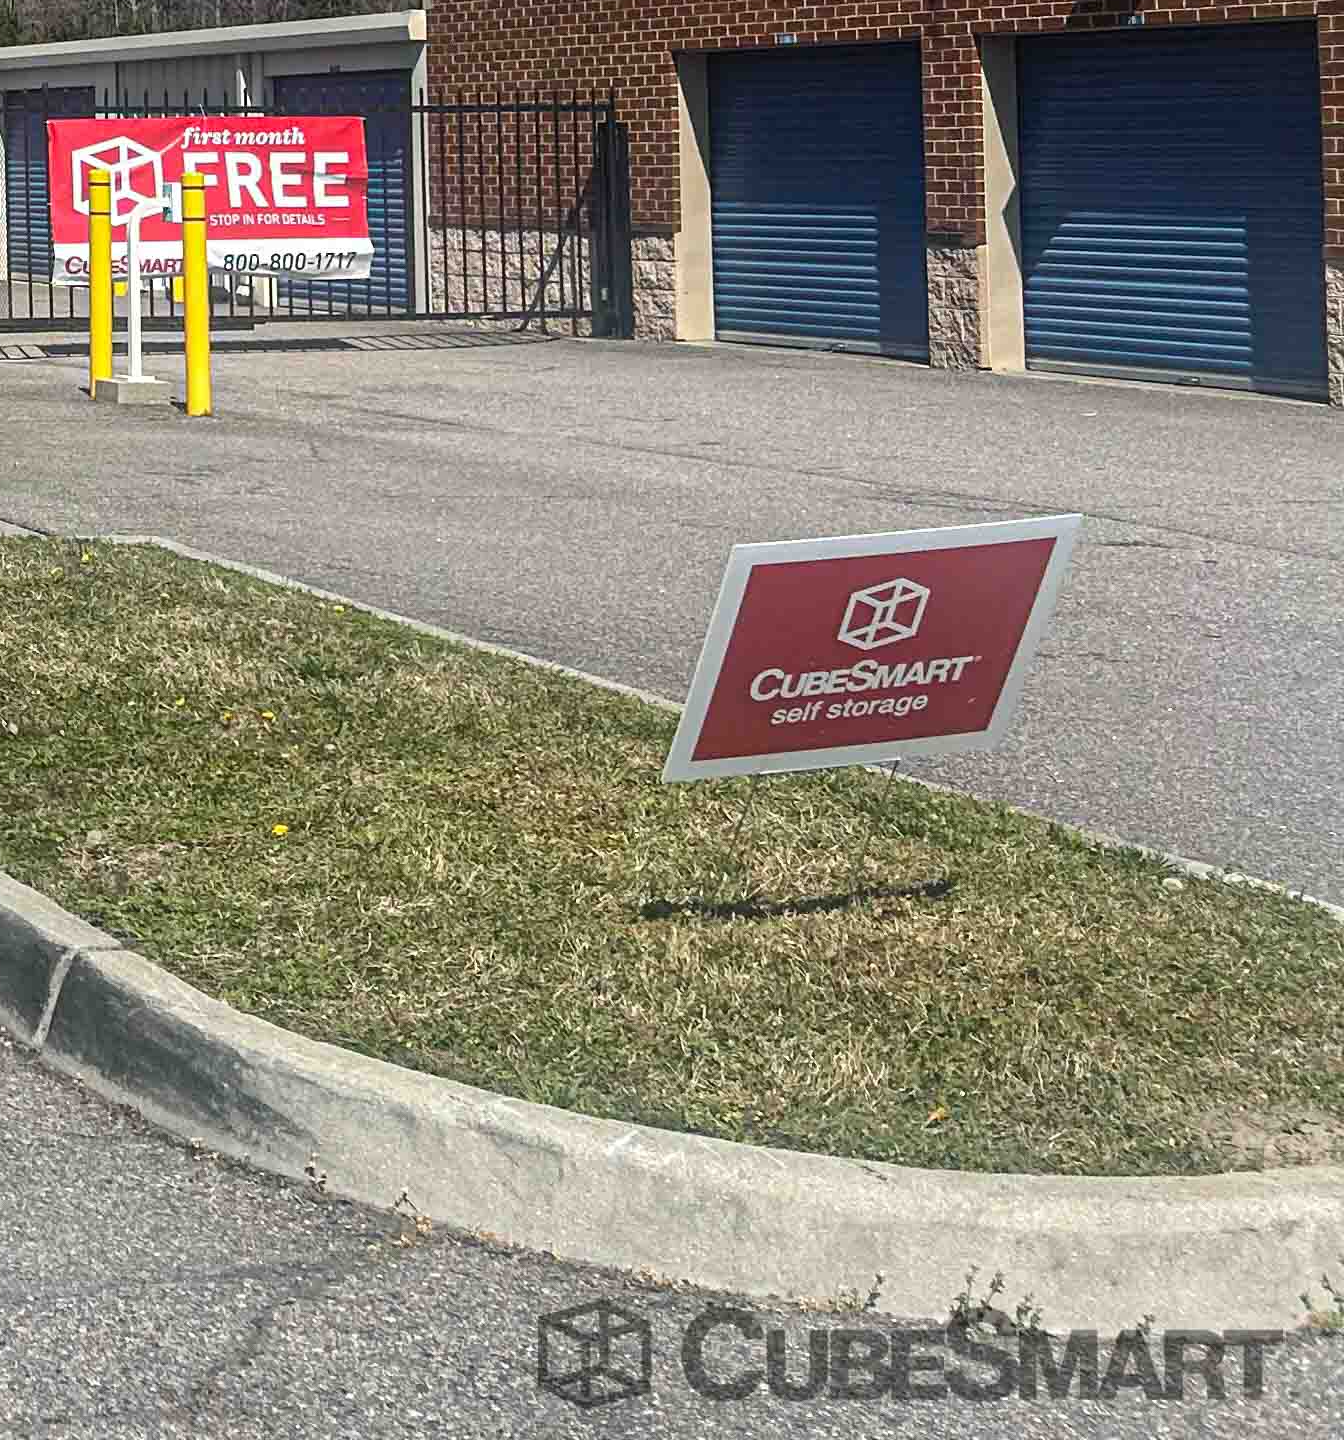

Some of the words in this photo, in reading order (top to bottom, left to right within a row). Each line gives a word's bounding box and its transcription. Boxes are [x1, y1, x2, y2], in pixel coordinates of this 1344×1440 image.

[181, 127, 231, 148] first
[235, 127, 305, 145] month
[182, 151, 350, 208] FREE
[209, 214, 240, 226] STOP
[242, 214, 255, 225] IN
[257, 214, 280, 225] FOR
[282, 213, 326, 225] DETAILS
[223, 252, 357, 272] 800-800-1717
[770, 702, 822, 727] self
[826, 693, 929, 721] storage
